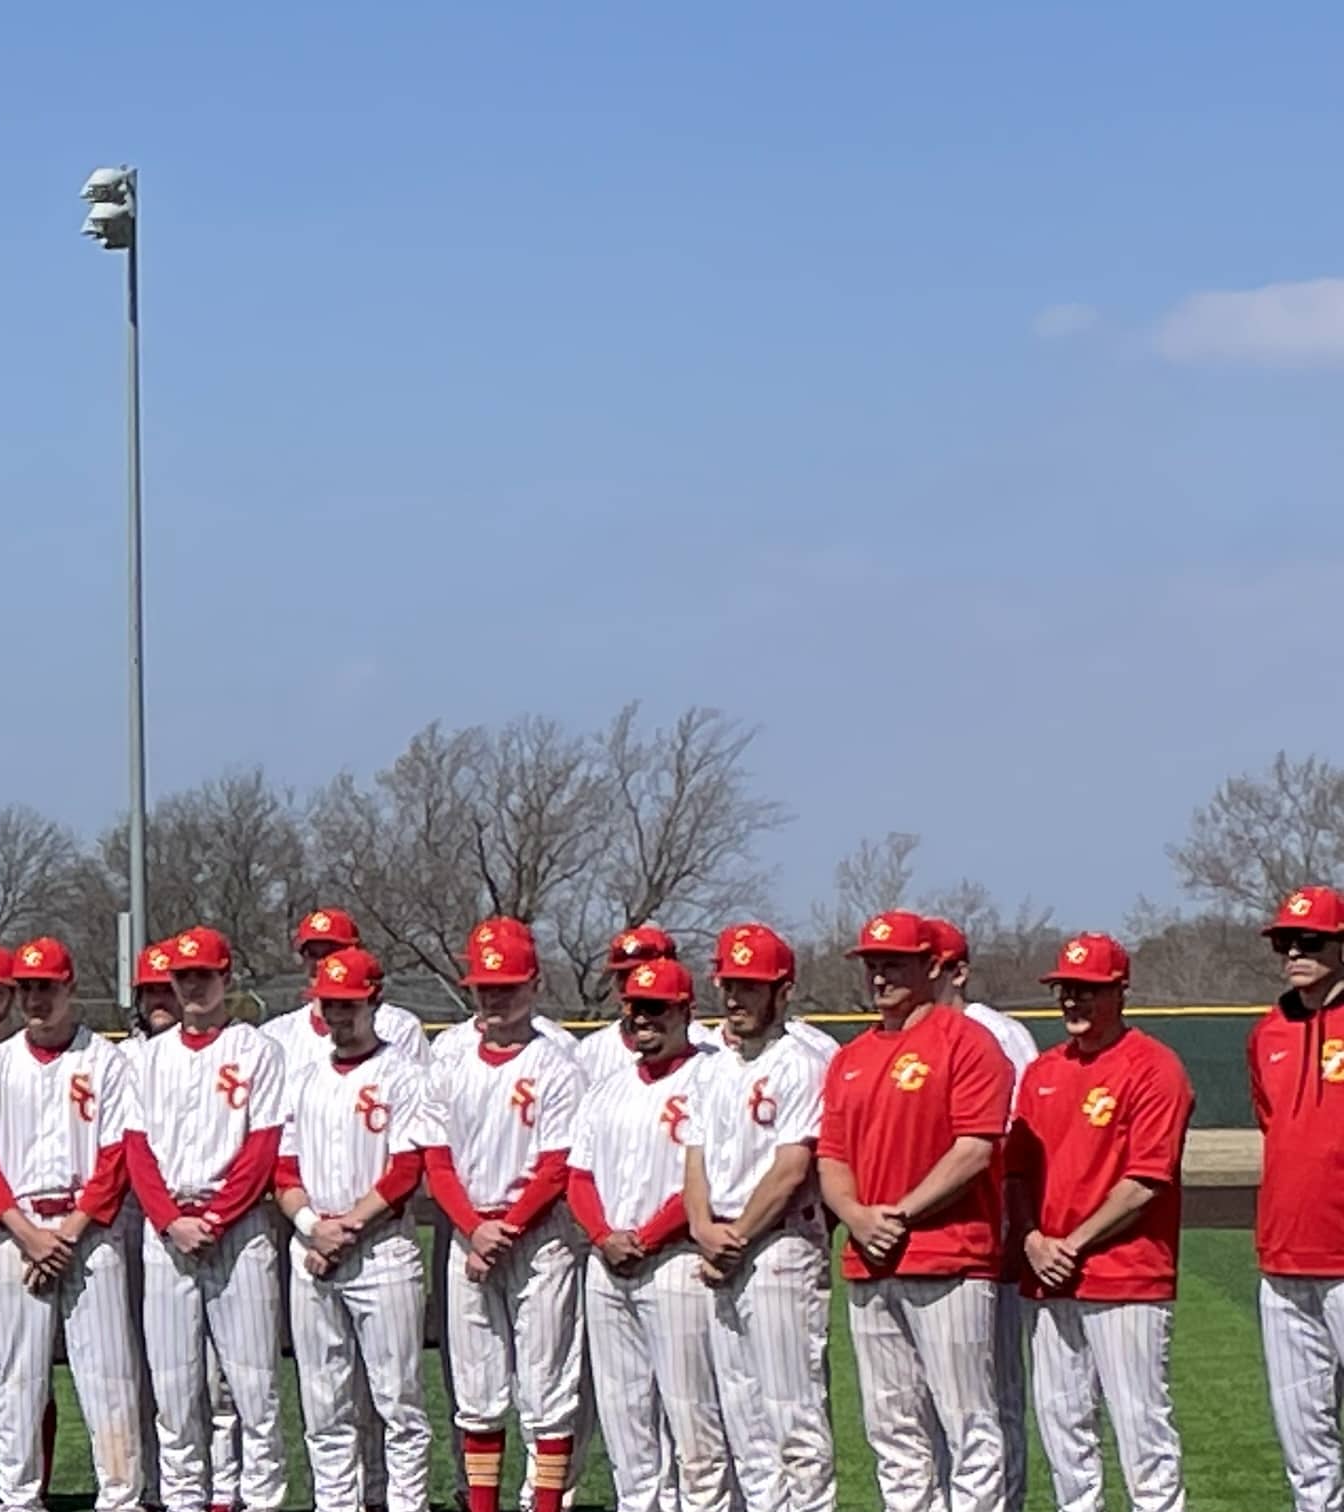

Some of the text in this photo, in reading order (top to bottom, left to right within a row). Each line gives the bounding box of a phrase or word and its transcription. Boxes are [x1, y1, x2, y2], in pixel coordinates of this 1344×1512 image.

[216, 1063, 250, 1110] SC
[891, 1053, 931, 1092] SC
[69, 1074, 95, 1122] SC
[355, 1083, 392, 1134] SC
[660, 1095, 690, 1145] SC
[1081, 1087, 1117, 1127] SC
